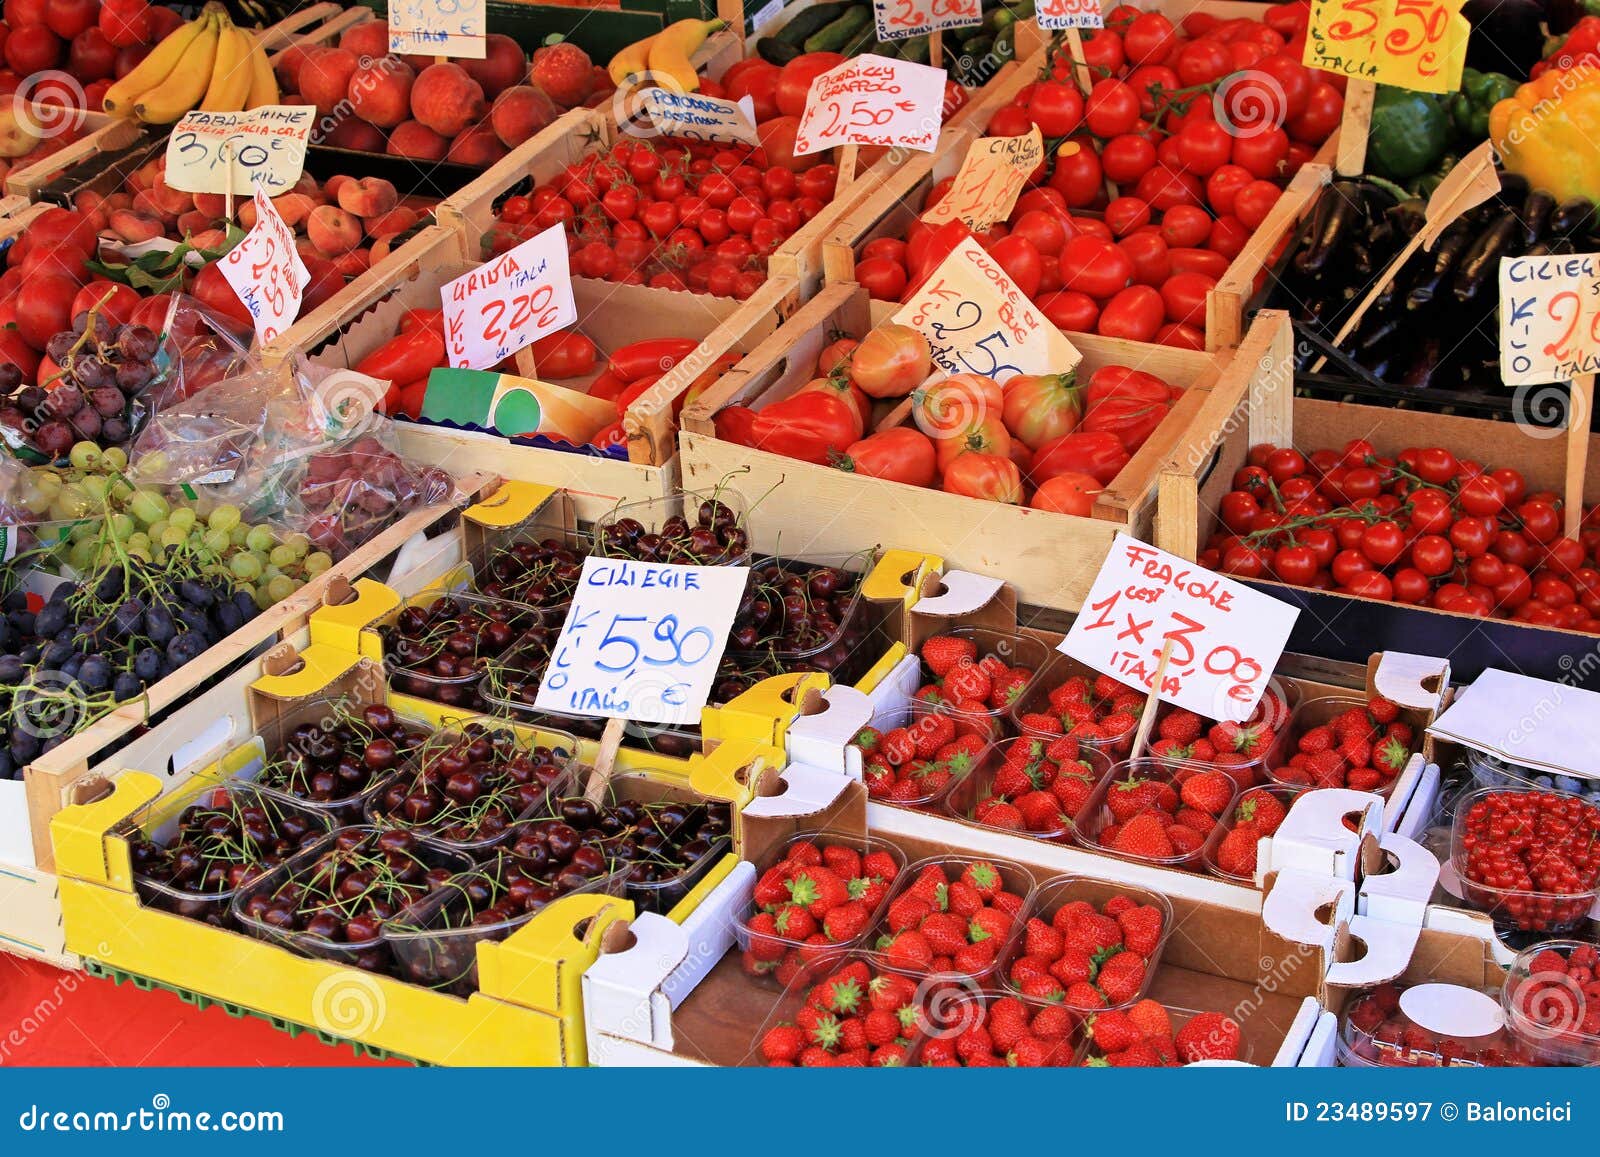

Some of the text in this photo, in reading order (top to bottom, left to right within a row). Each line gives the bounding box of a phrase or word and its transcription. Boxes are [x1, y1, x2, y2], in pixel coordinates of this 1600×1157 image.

[819, 100, 894, 138] 2,50
[964, 249, 1020, 305] CUORE
[480, 284, 554, 347] 2,20
[536, 305, 559, 329] €
[997, 300, 1028, 345] BUE
[1509, 296, 1537, 373] KILO
[587, 562, 701, 591] CILIEGIE
[1125, 544, 1236, 613] FRAGOLE
[1083, 589, 1122, 631] 1
[547, 604, 601, 691] KILO
[593, 612, 715, 681] 5,90
[659, 682, 692, 706] €
